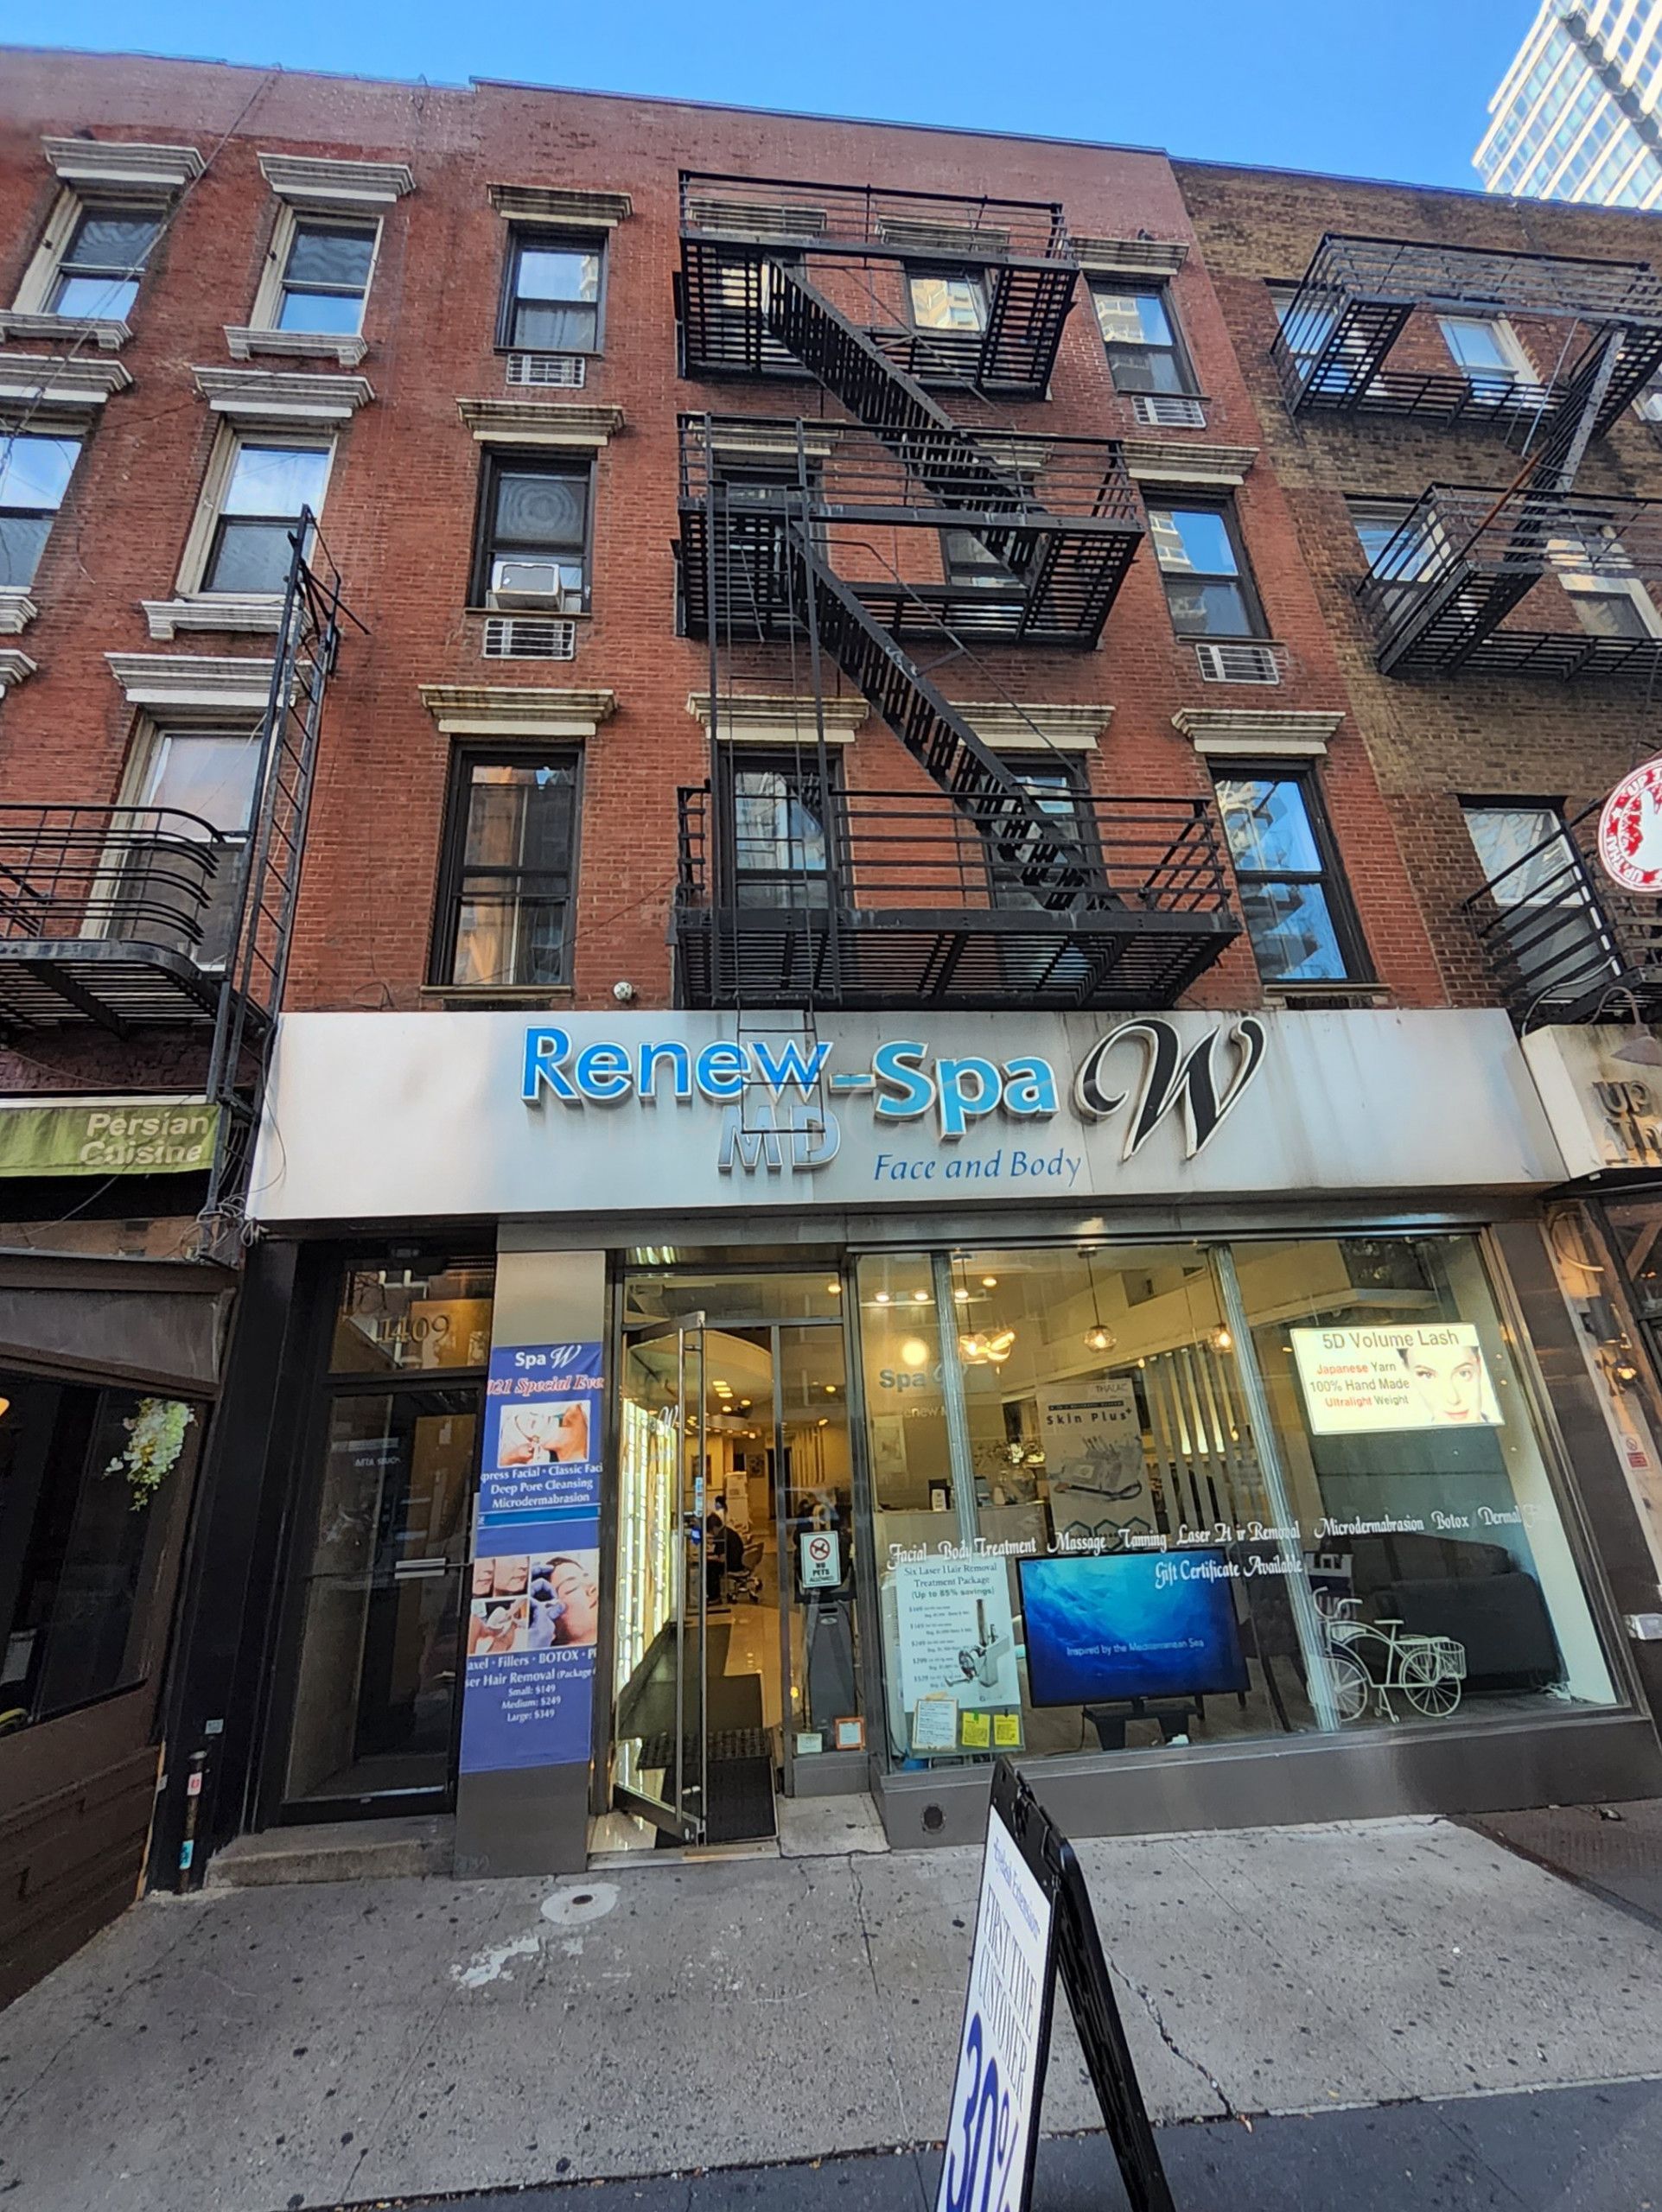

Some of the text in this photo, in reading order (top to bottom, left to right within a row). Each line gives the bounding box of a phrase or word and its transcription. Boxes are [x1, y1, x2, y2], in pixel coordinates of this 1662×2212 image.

[1075, 1015, 1268, 1161] W
[87, 1112, 208, 1137] Persian
[716, 1104, 842, 1173] MD
[79, 1138, 203, 1165] Cuisine
[874, 1147, 1082, 1187] Face and Body
[377, 1314, 450, 1344] 1409
[1322, 1328, 1460, 1350] 5D Volume Lash
[514, 1344, 583, 1370] Spa W
[1316, 1361, 1397, 1376] Japanese Yarn
[514, 1375, 570, 1396] Special
[879, 1369, 927, 1393] Spa
[1309, 1378, 1410, 1393] 100% Hand Made
[1325, 1394, 1410, 1408] Ultralight Weight
[513, 1468, 540, 1478] Facial
[548, 1465, 582, 1476] Classic
[491, 1478, 594, 1496] Deep Pore Cleansing
[492, 1492, 590, 1509] Microdermabrasion
[887, 1542, 927, 1569] Facial
[938, 1540, 973, 1563] Body
[973, 1537, 1037, 1557] Treatment
[1047, 1529, 1107, 1556] Massage
[1118, 1528, 1167, 1554] Tanning
[1175, 1523, 1210, 1545] Laser
[1247, 1520, 1301, 1540] Removal
[1314, 1513, 1425, 1538] Microdermabrasion
[1430, 1510, 1469, 1529] Botox
[1477, 1505, 1521, 1526] Dermal
[919, 1567, 940, 1575] Laser
[943, 1565, 961, 1573] Hair
[964, 1563, 997, 1572] Removal
[1155, 1560, 1177, 1589] Gift
[1180, 1559, 1240, 1583] Certificate
[1243, 1554, 1303, 1578] Available
[914, 1576, 990, 1587] Treatment Package
[498, 1655, 529, 1668] Fillers
[538, 1649, 579, 1664] BOTOX
[1067, 1645, 1099, 1656] Inspired
[1101, 1644, 1111, 1656] by
[1113, 1644, 1127, 1653] the
[483, 1673, 507, 1687] Hair
[510, 1668, 555, 1684] Removal
[508, 1684, 556, 1697] Small: $149
[501, 1695, 562, 1710] Medium: $249
[506, 1709, 555, 1724] Large: $349
[984, 1884, 1037, 2043] FIRST TIME
[979, 1944, 1028, 2112] CUSTOMER
